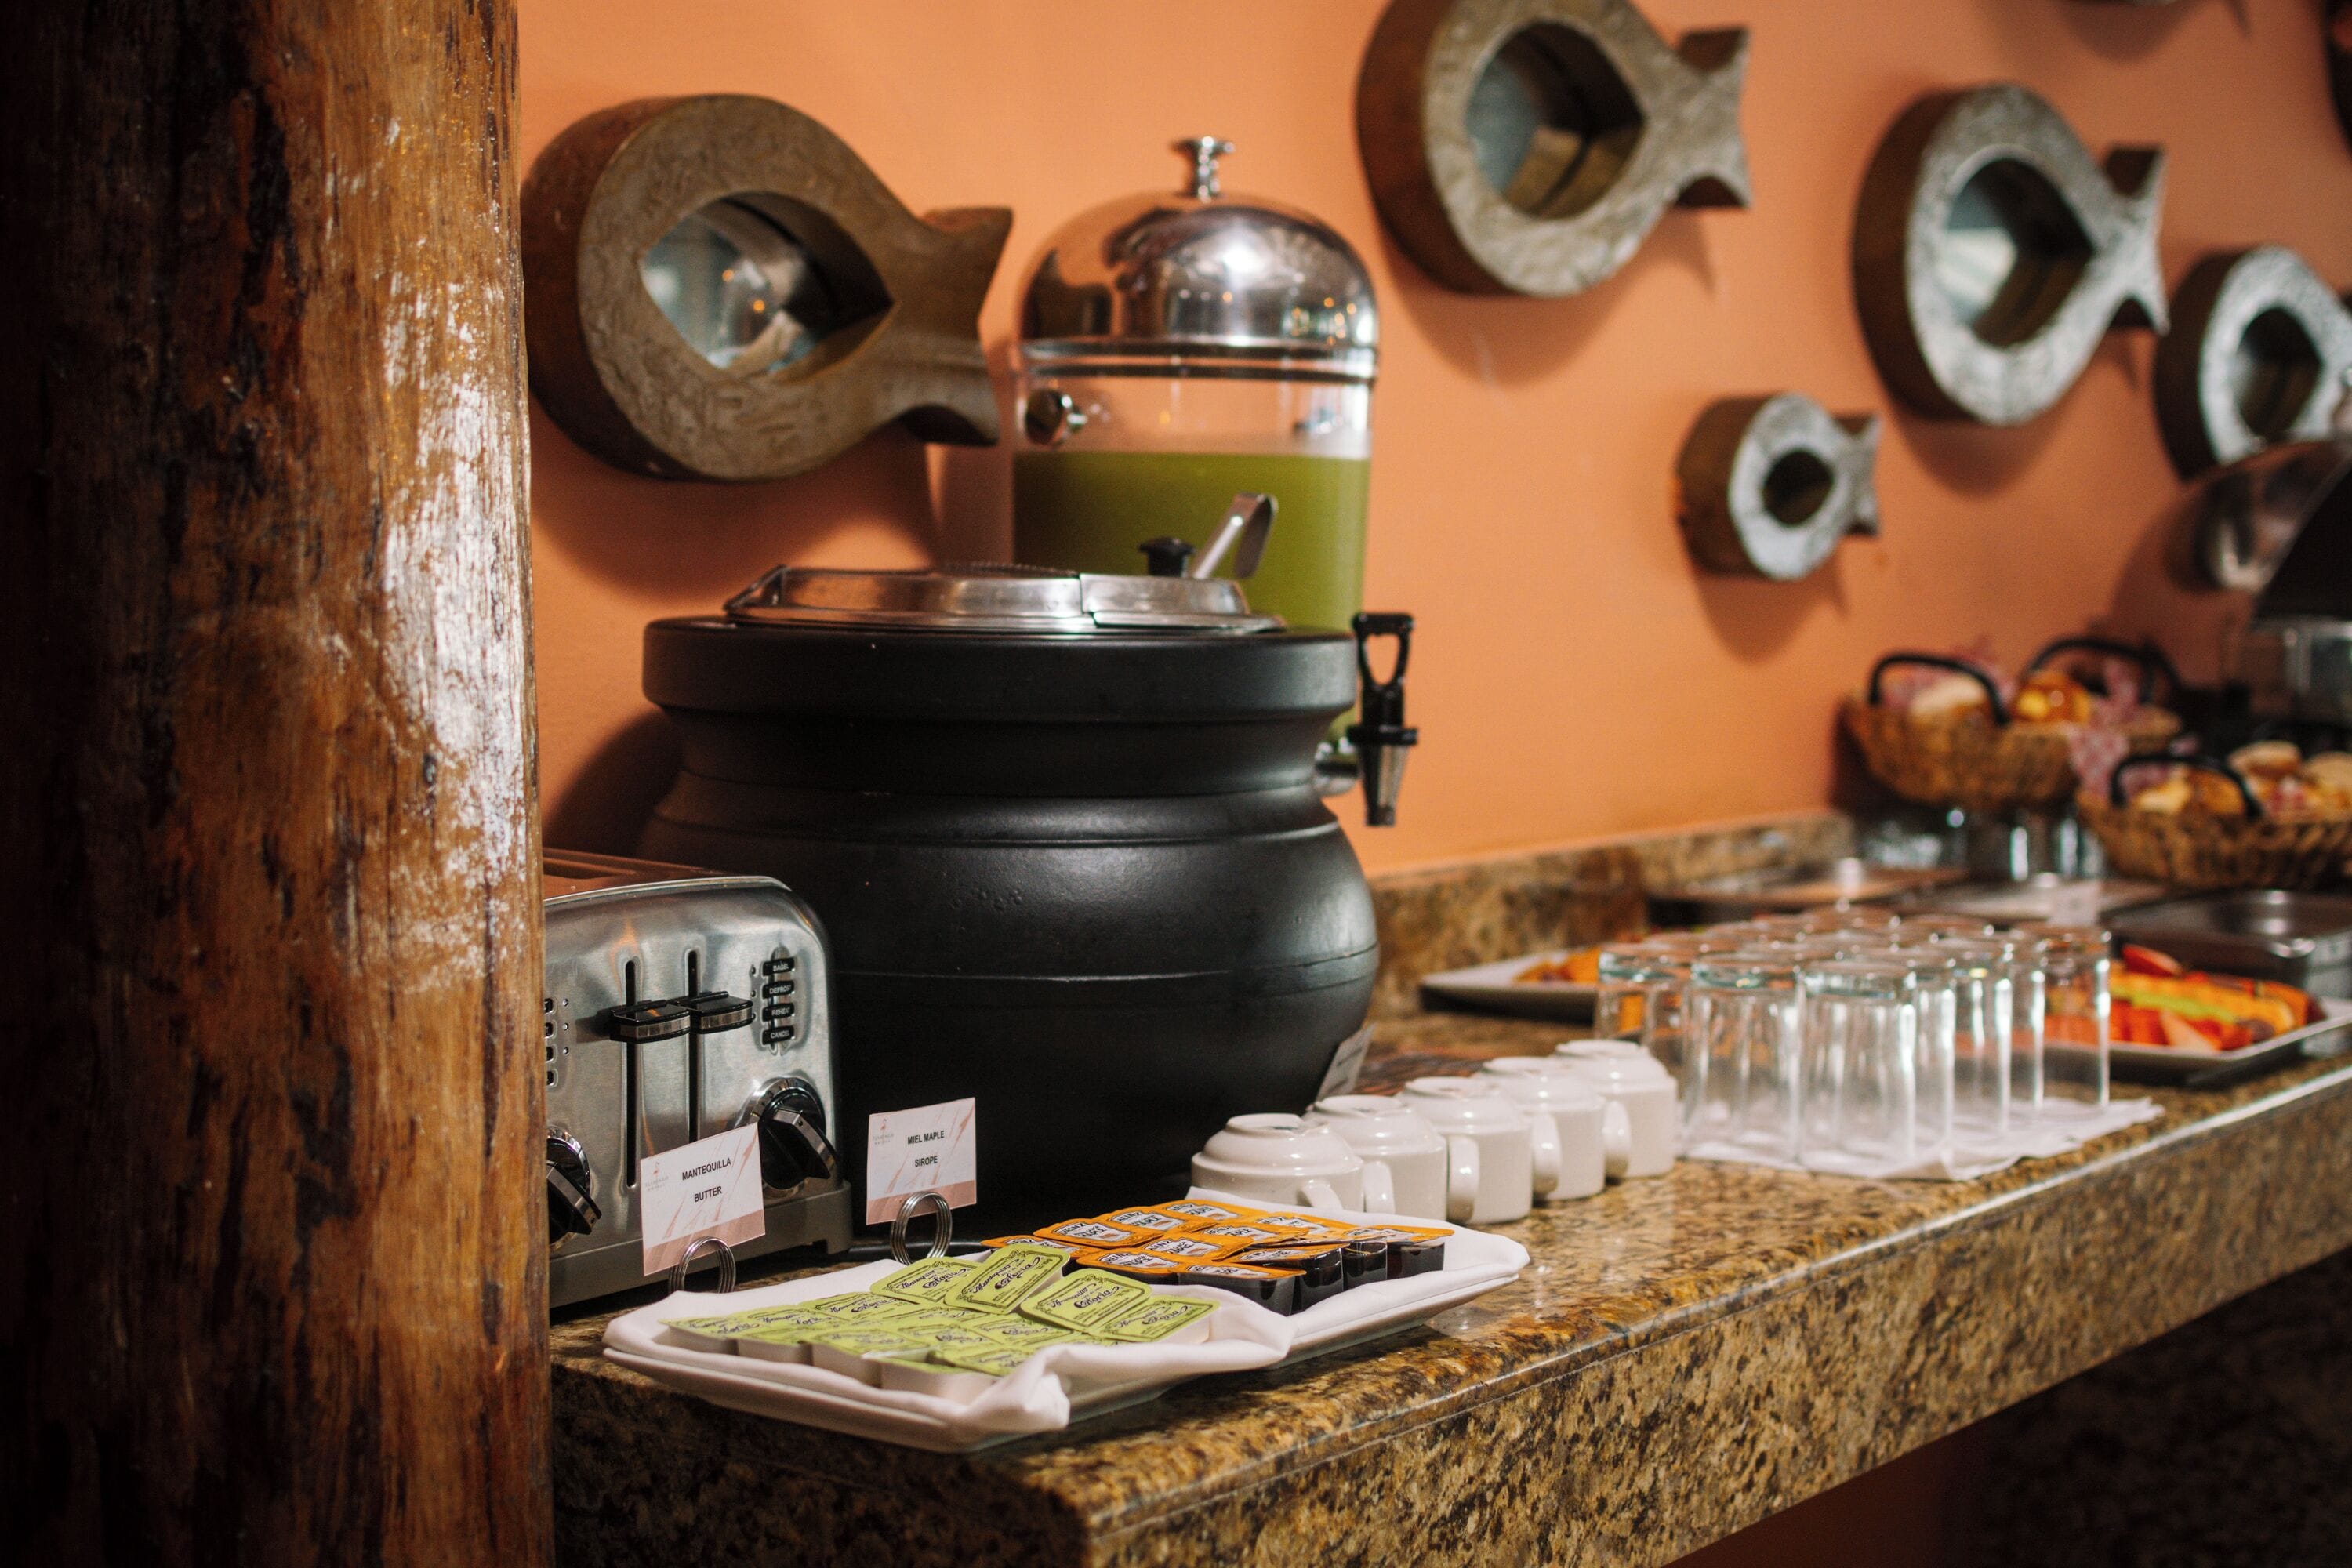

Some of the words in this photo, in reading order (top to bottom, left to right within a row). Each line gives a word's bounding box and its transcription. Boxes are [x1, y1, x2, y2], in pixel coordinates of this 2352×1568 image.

[773, 964, 789, 972] BAGEL
[769, 984, 792, 994] DEFROST
[771, 1007, 790, 1016] REHEAT
[771, 1030, 790, 1039] CANCEL
[907, 1134, 923, 1145] MIEL
[924, 1130, 945, 1142] MAPLE
[914, 1155, 938, 1167] SIROPE
[681, 1157, 731, 1181] MANTEQUILLA
[694, 1185, 723, 1203] BUTTER
[1073, 1286, 1120, 1308] Gloria
